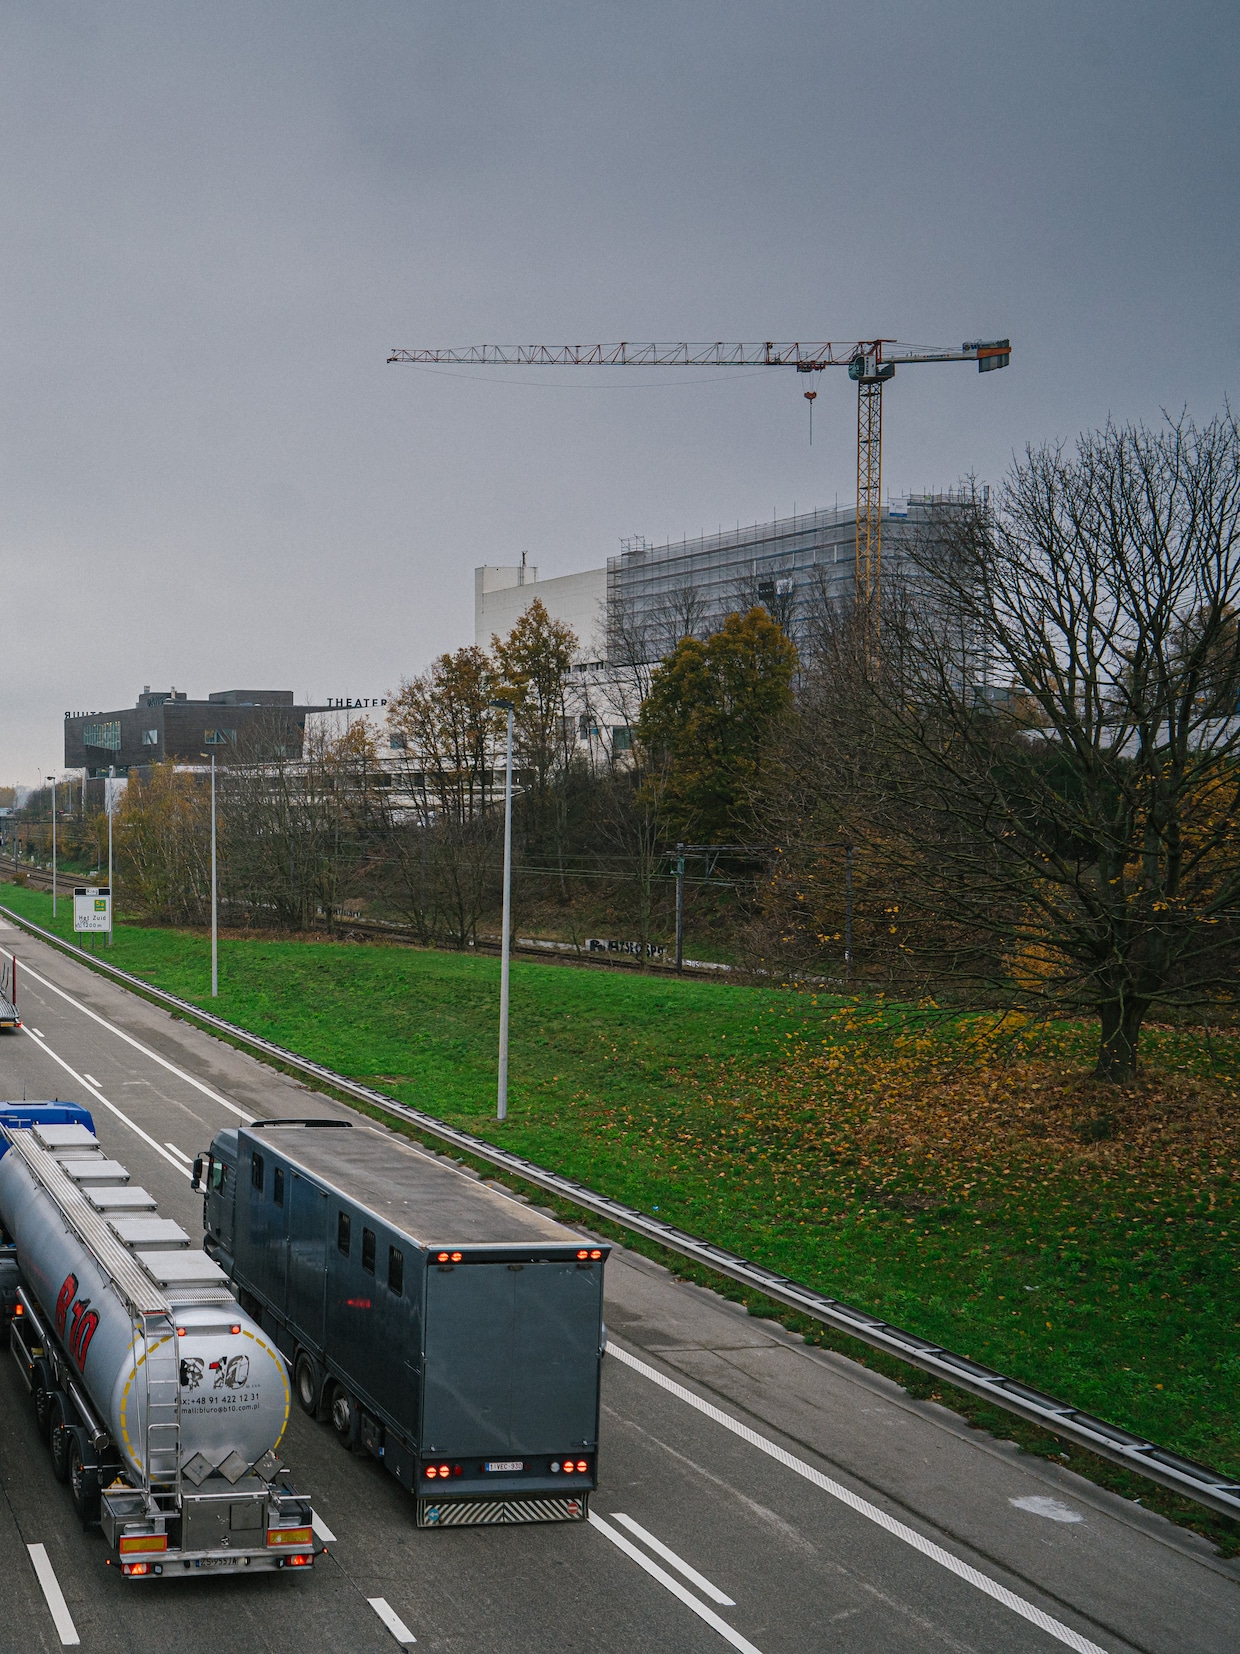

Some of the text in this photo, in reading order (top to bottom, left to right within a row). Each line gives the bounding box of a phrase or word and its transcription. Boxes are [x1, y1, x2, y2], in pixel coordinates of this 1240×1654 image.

[327, 698, 387, 707] THEATER
[209, 1396, 219, 1404] 91
[222, 1395, 237, 1403] 422
[240, 1394, 248, 1402] 12
[251, 1393, 260, 1401] 31
